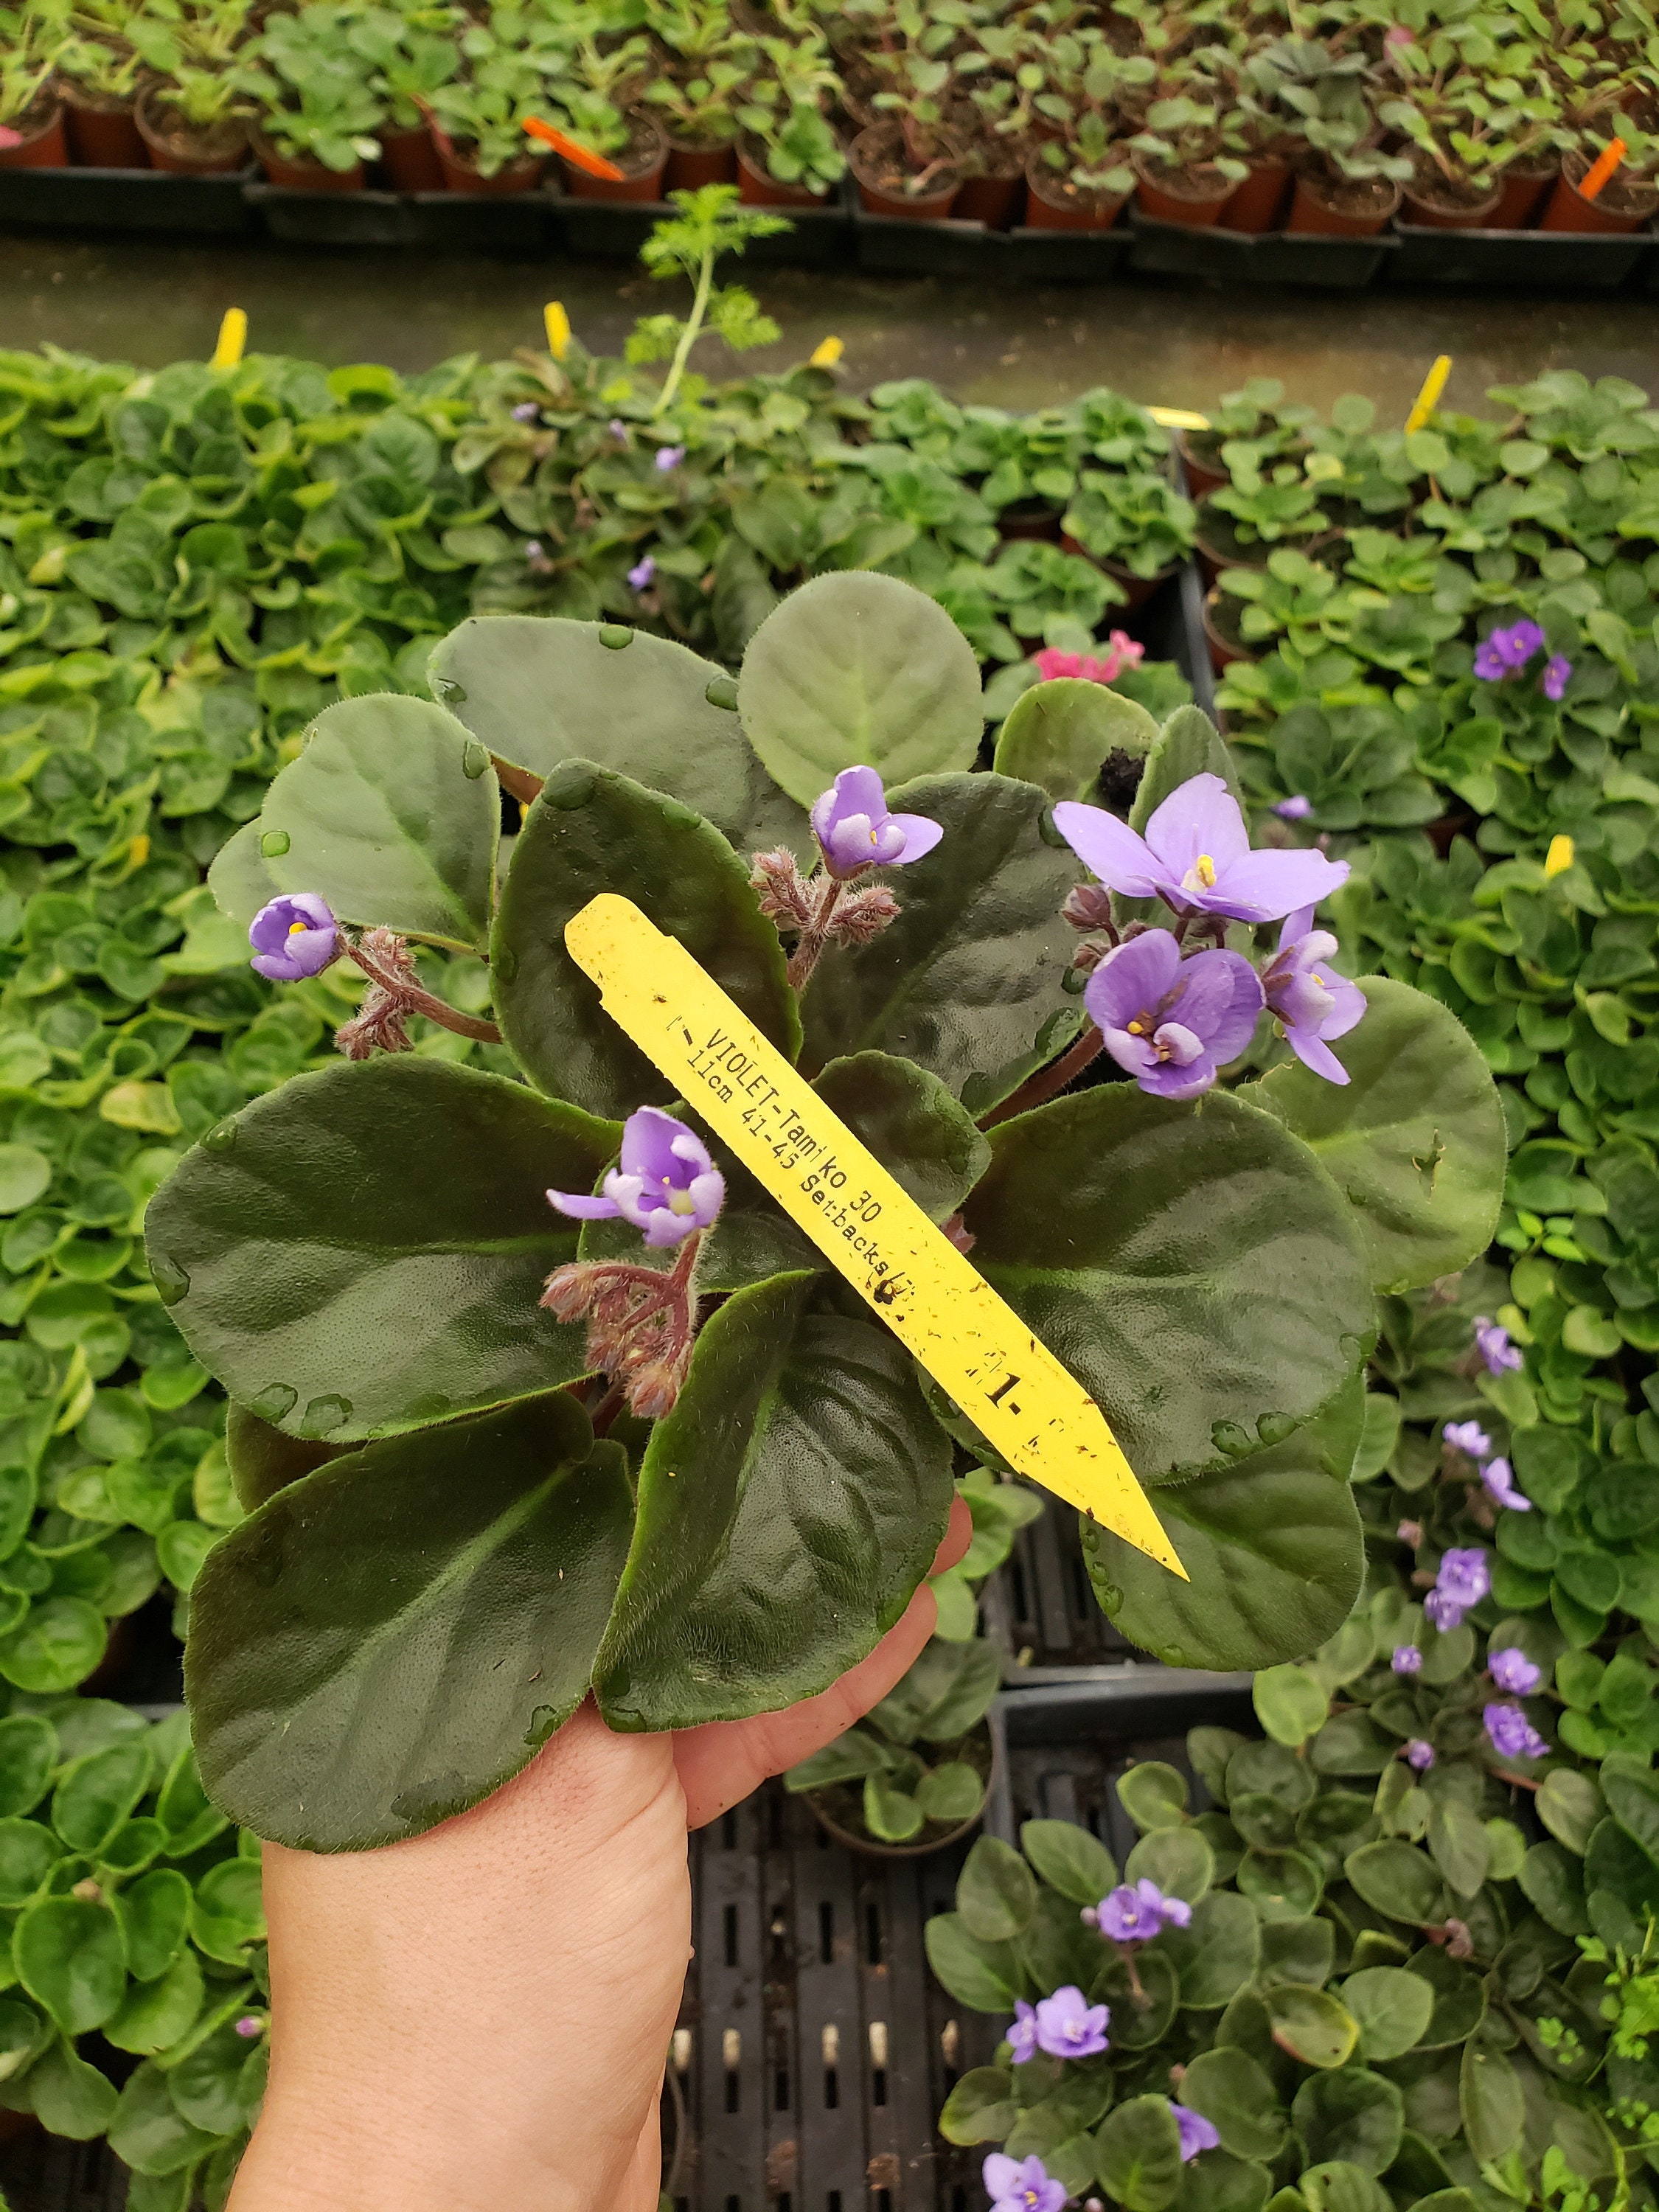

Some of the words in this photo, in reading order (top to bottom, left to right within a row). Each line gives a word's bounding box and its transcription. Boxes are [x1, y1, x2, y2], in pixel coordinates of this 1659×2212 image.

[686, 1049, 734, 1104] 11cm
[741, 1107, 800, 1169] 41-45
[849, 1189, 882, 1222] 30
